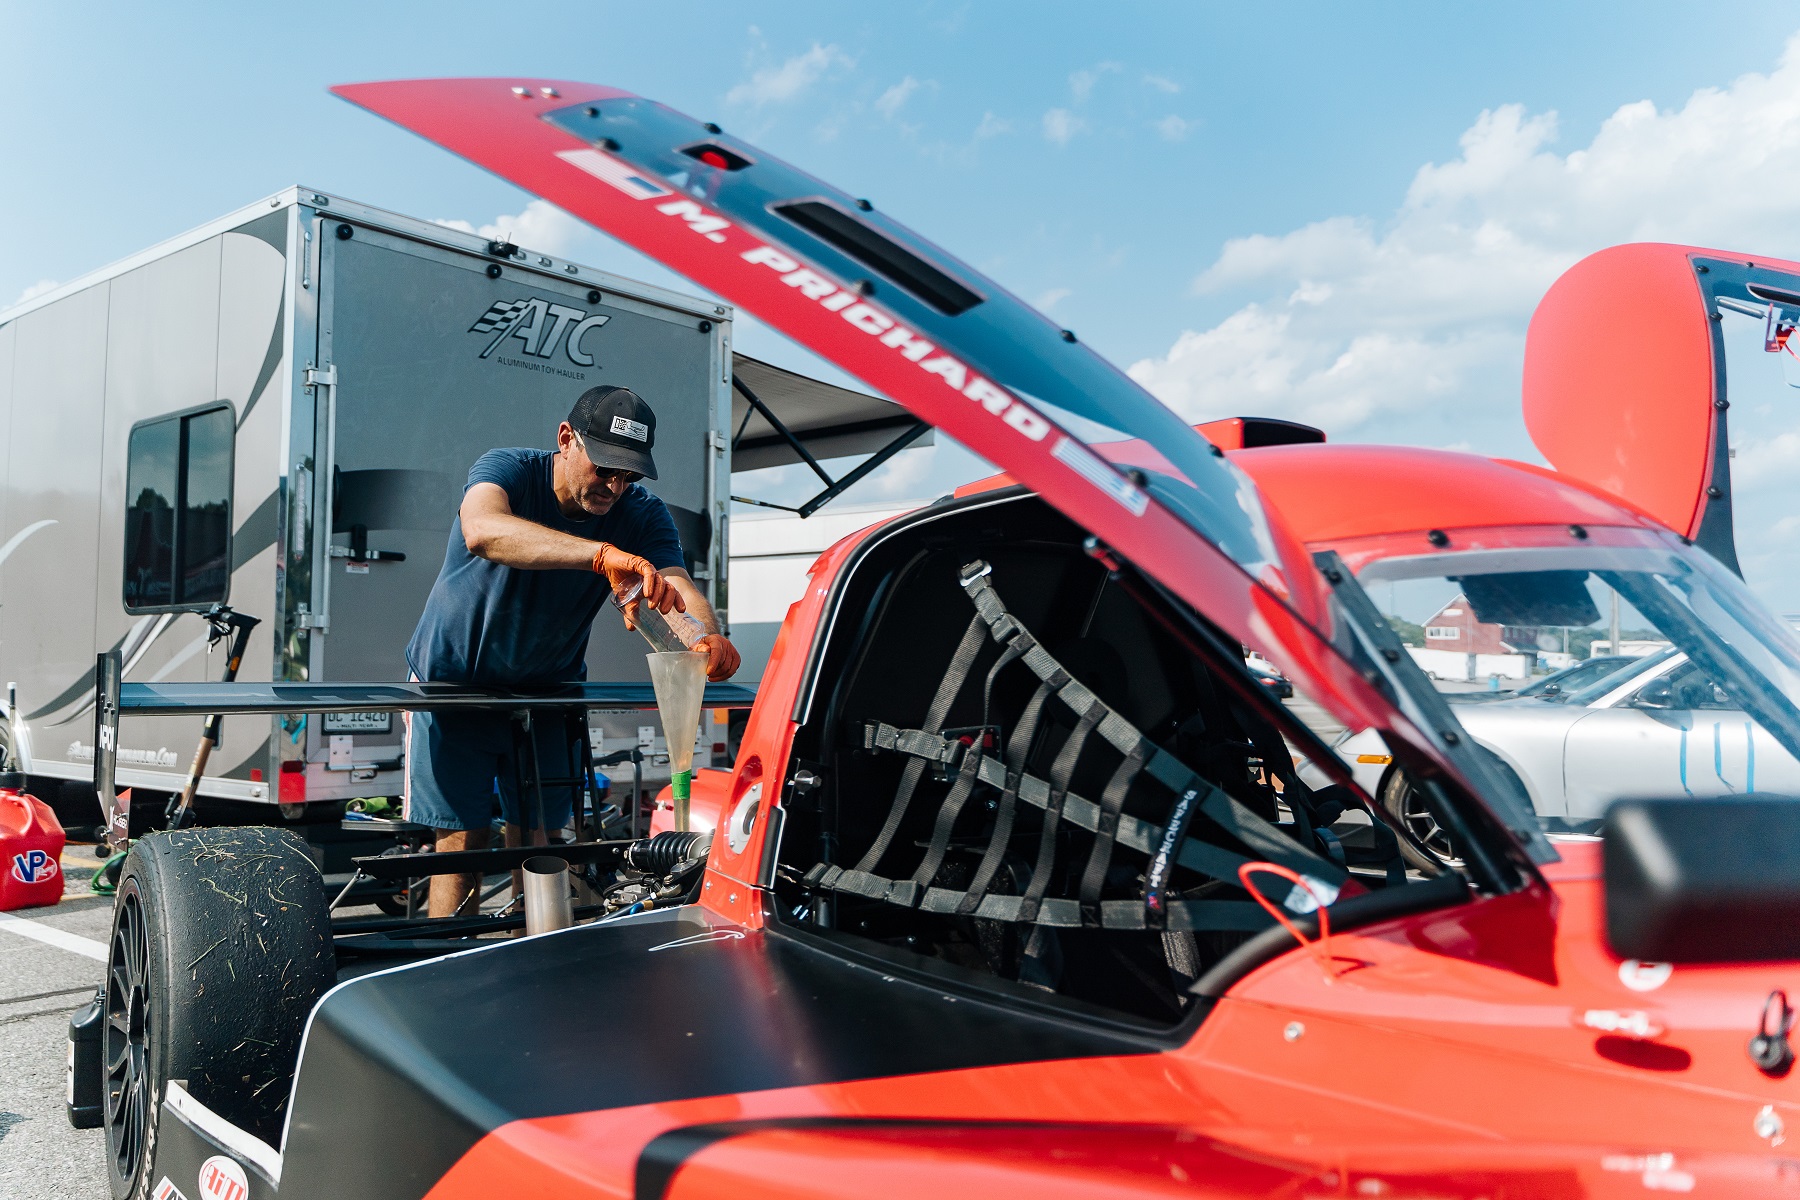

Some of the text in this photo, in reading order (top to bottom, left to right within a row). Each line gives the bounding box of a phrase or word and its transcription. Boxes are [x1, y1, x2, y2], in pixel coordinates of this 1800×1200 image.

[478, 297, 612, 367] ATC
[656, 200, 1051, 442] M. PRICHARD
[498, 356, 586, 381] ALUMINUM TOY HAULER
[12, 849, 48, 883] VP
[1150, 790, 1197, 888] SAFECRAFT
